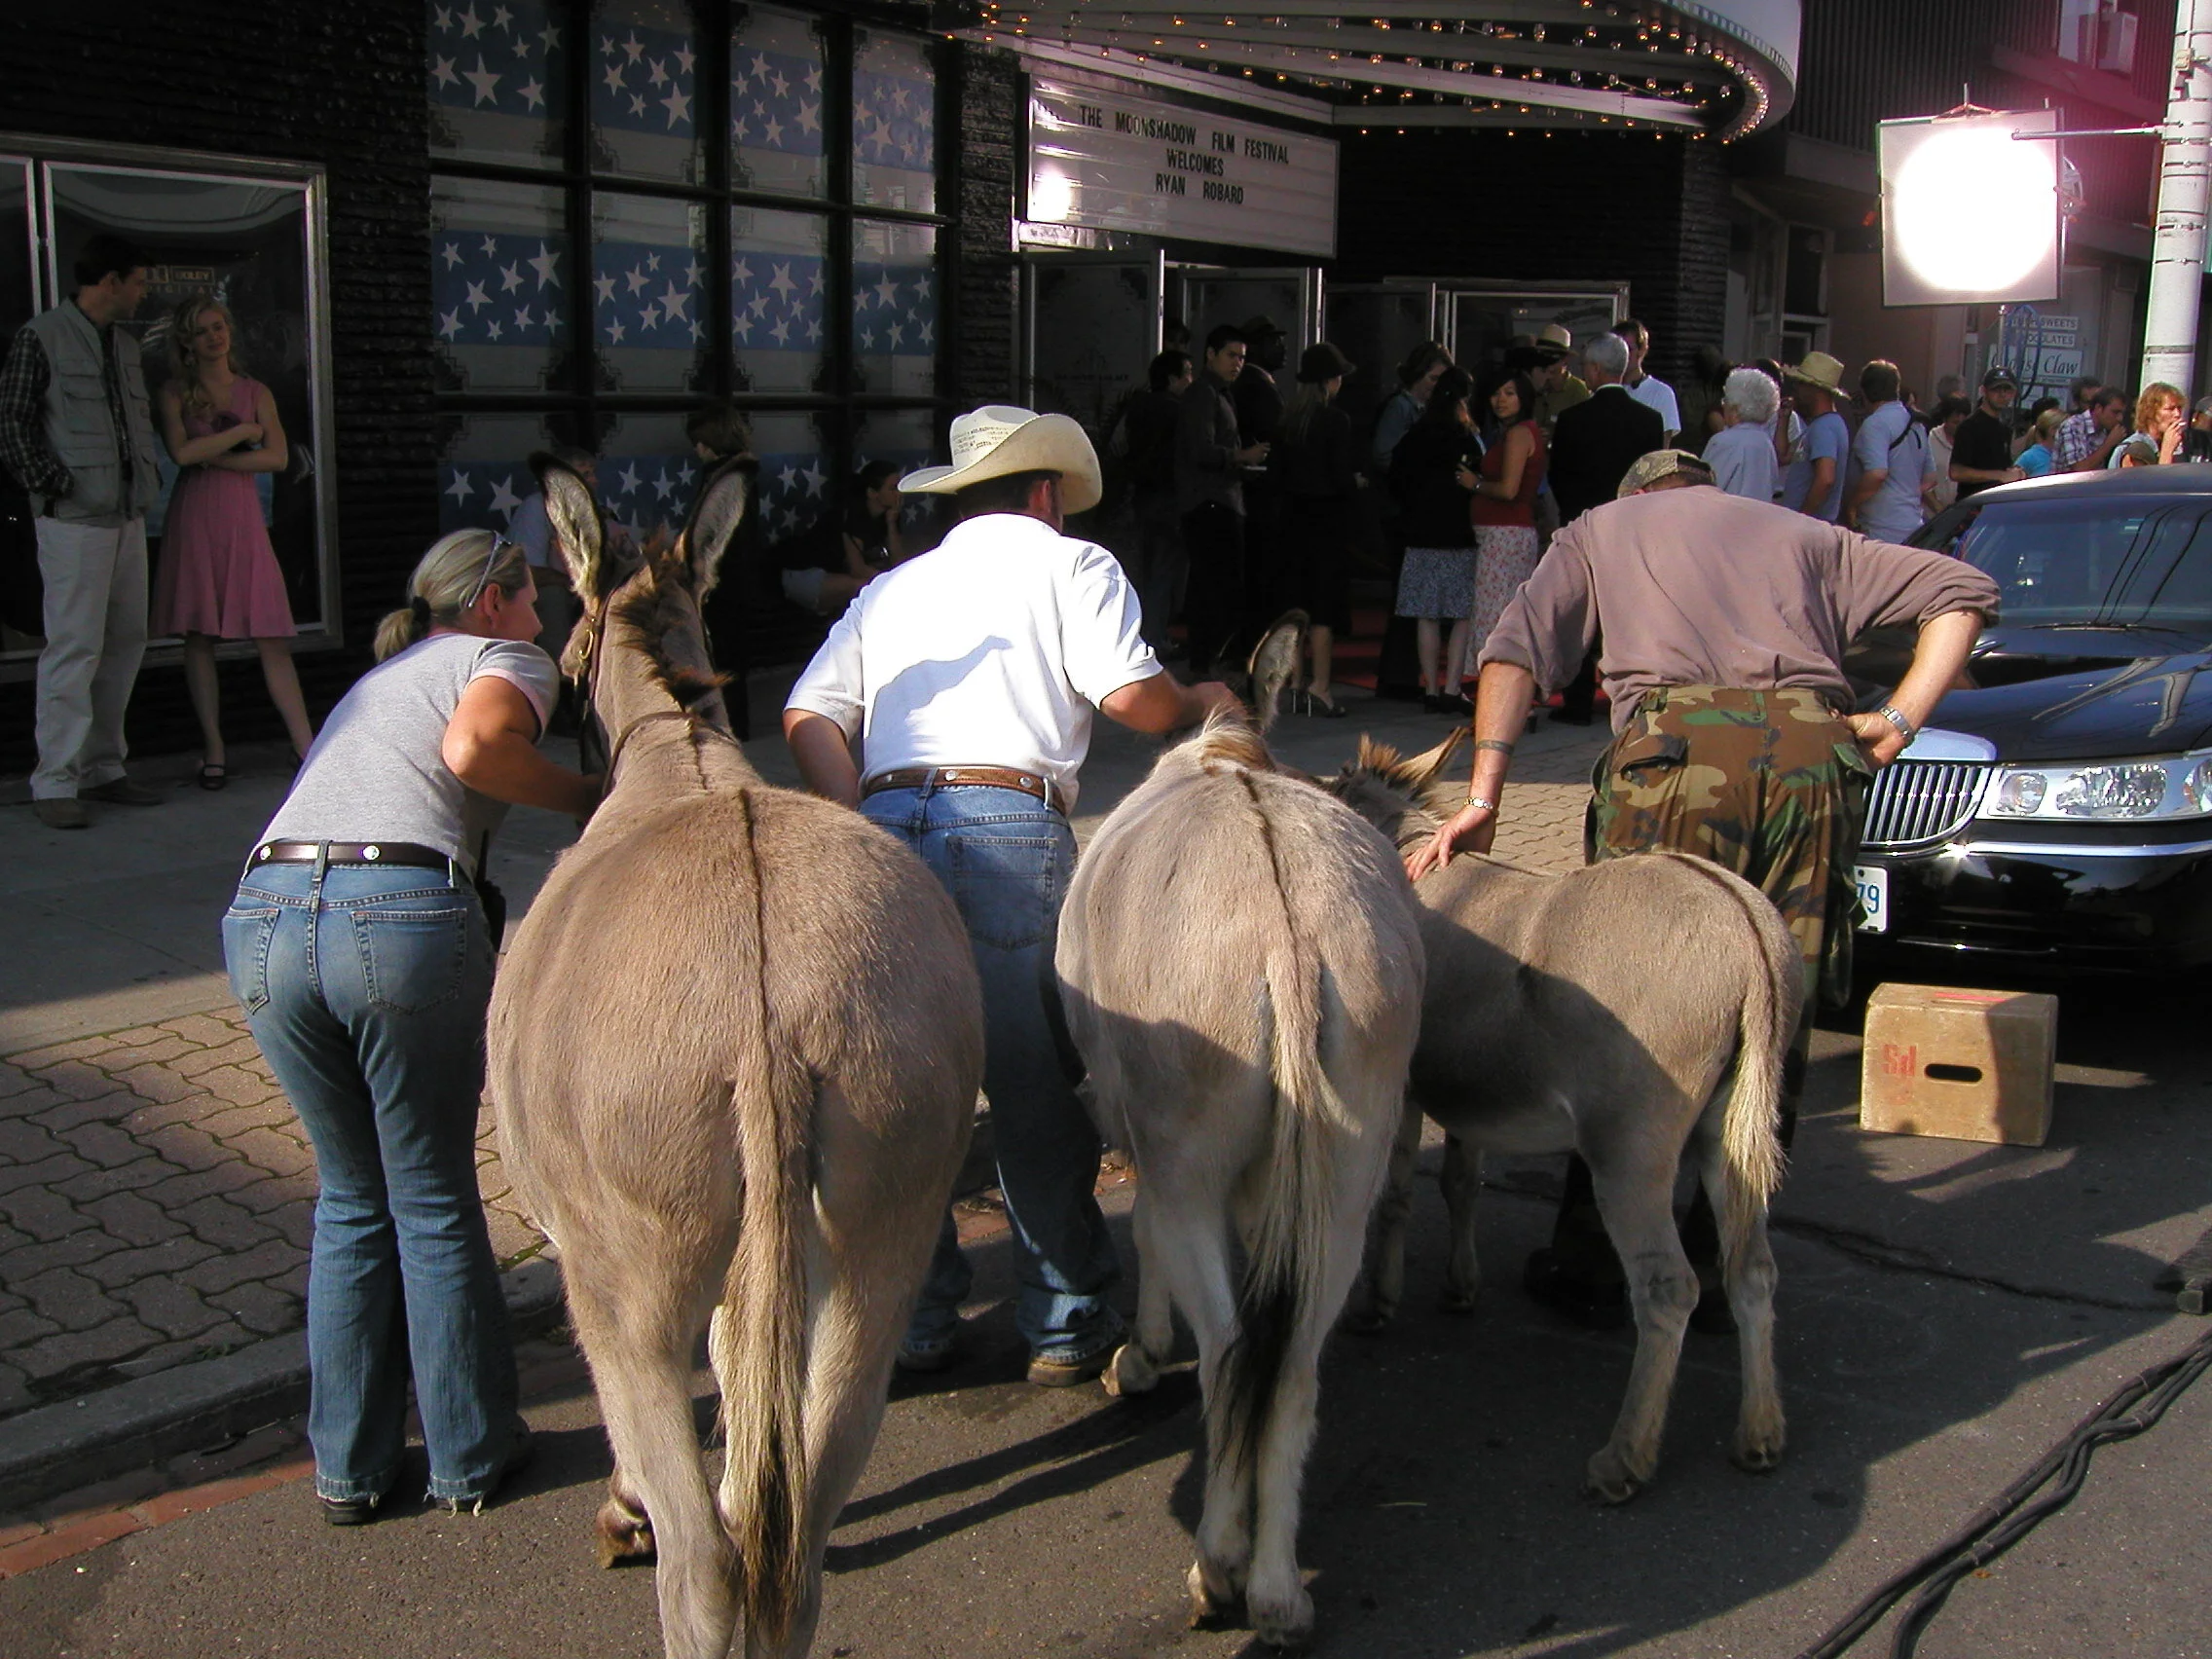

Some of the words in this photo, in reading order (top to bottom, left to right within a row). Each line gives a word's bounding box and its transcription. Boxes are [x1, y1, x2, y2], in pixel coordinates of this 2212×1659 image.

[1079, 105, 1103, 129] THE
[1115, 111, 1197, 146] MOONSHADOW
[1211, 131, 1235, 153] FILM
[1244, 138, 1289, 165] FESTIVAL
[1166, 148, 1225, 176] WELCOMES
[1156, 173, 1187, 196] RYAN
[1202, 181, 1244, 204] ROBARD
[2041, 317, 2077, 329] SWEETS
[2044, 352, 2079, 375] Claw
